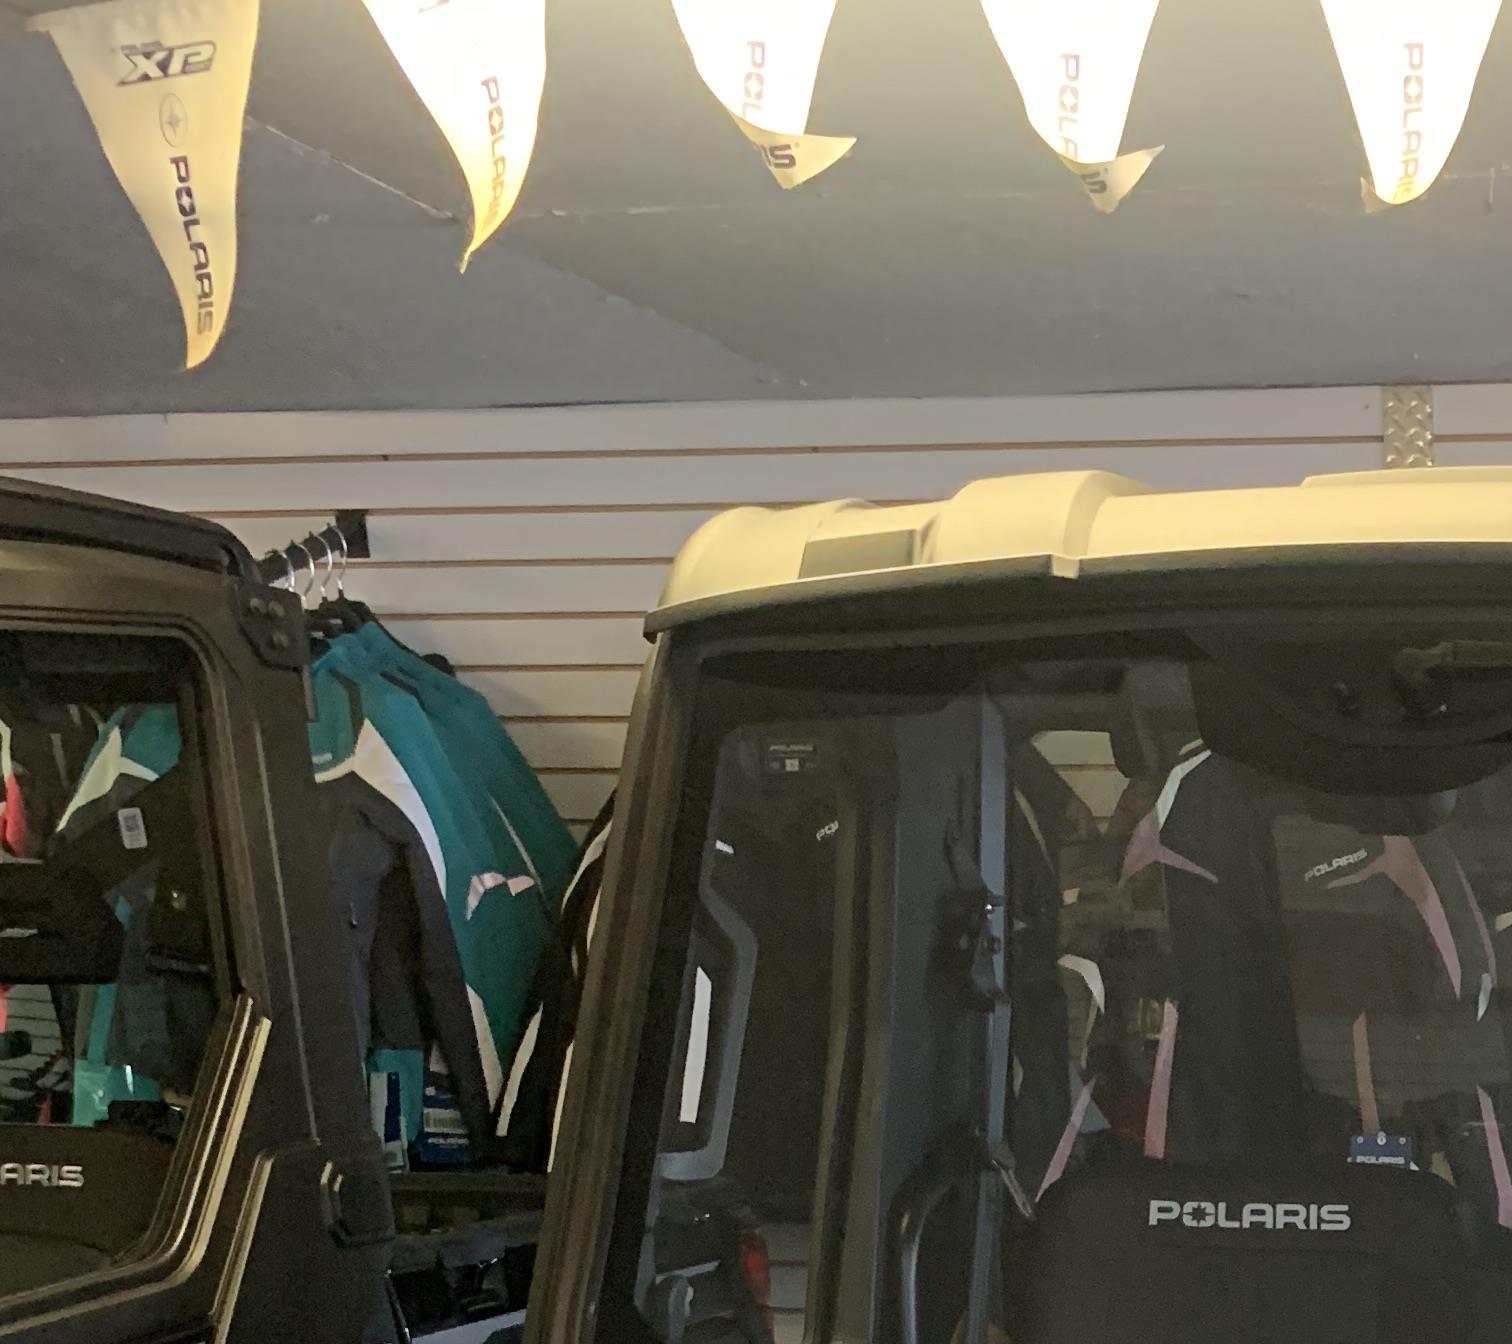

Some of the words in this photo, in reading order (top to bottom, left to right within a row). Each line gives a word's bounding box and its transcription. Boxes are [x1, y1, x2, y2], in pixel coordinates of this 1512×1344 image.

[169, 155, 213, 336] POLARIS
[1304, 848, 1368, 882] POLARIS
[1147, 1199, 1352, 1231] POLARIS
